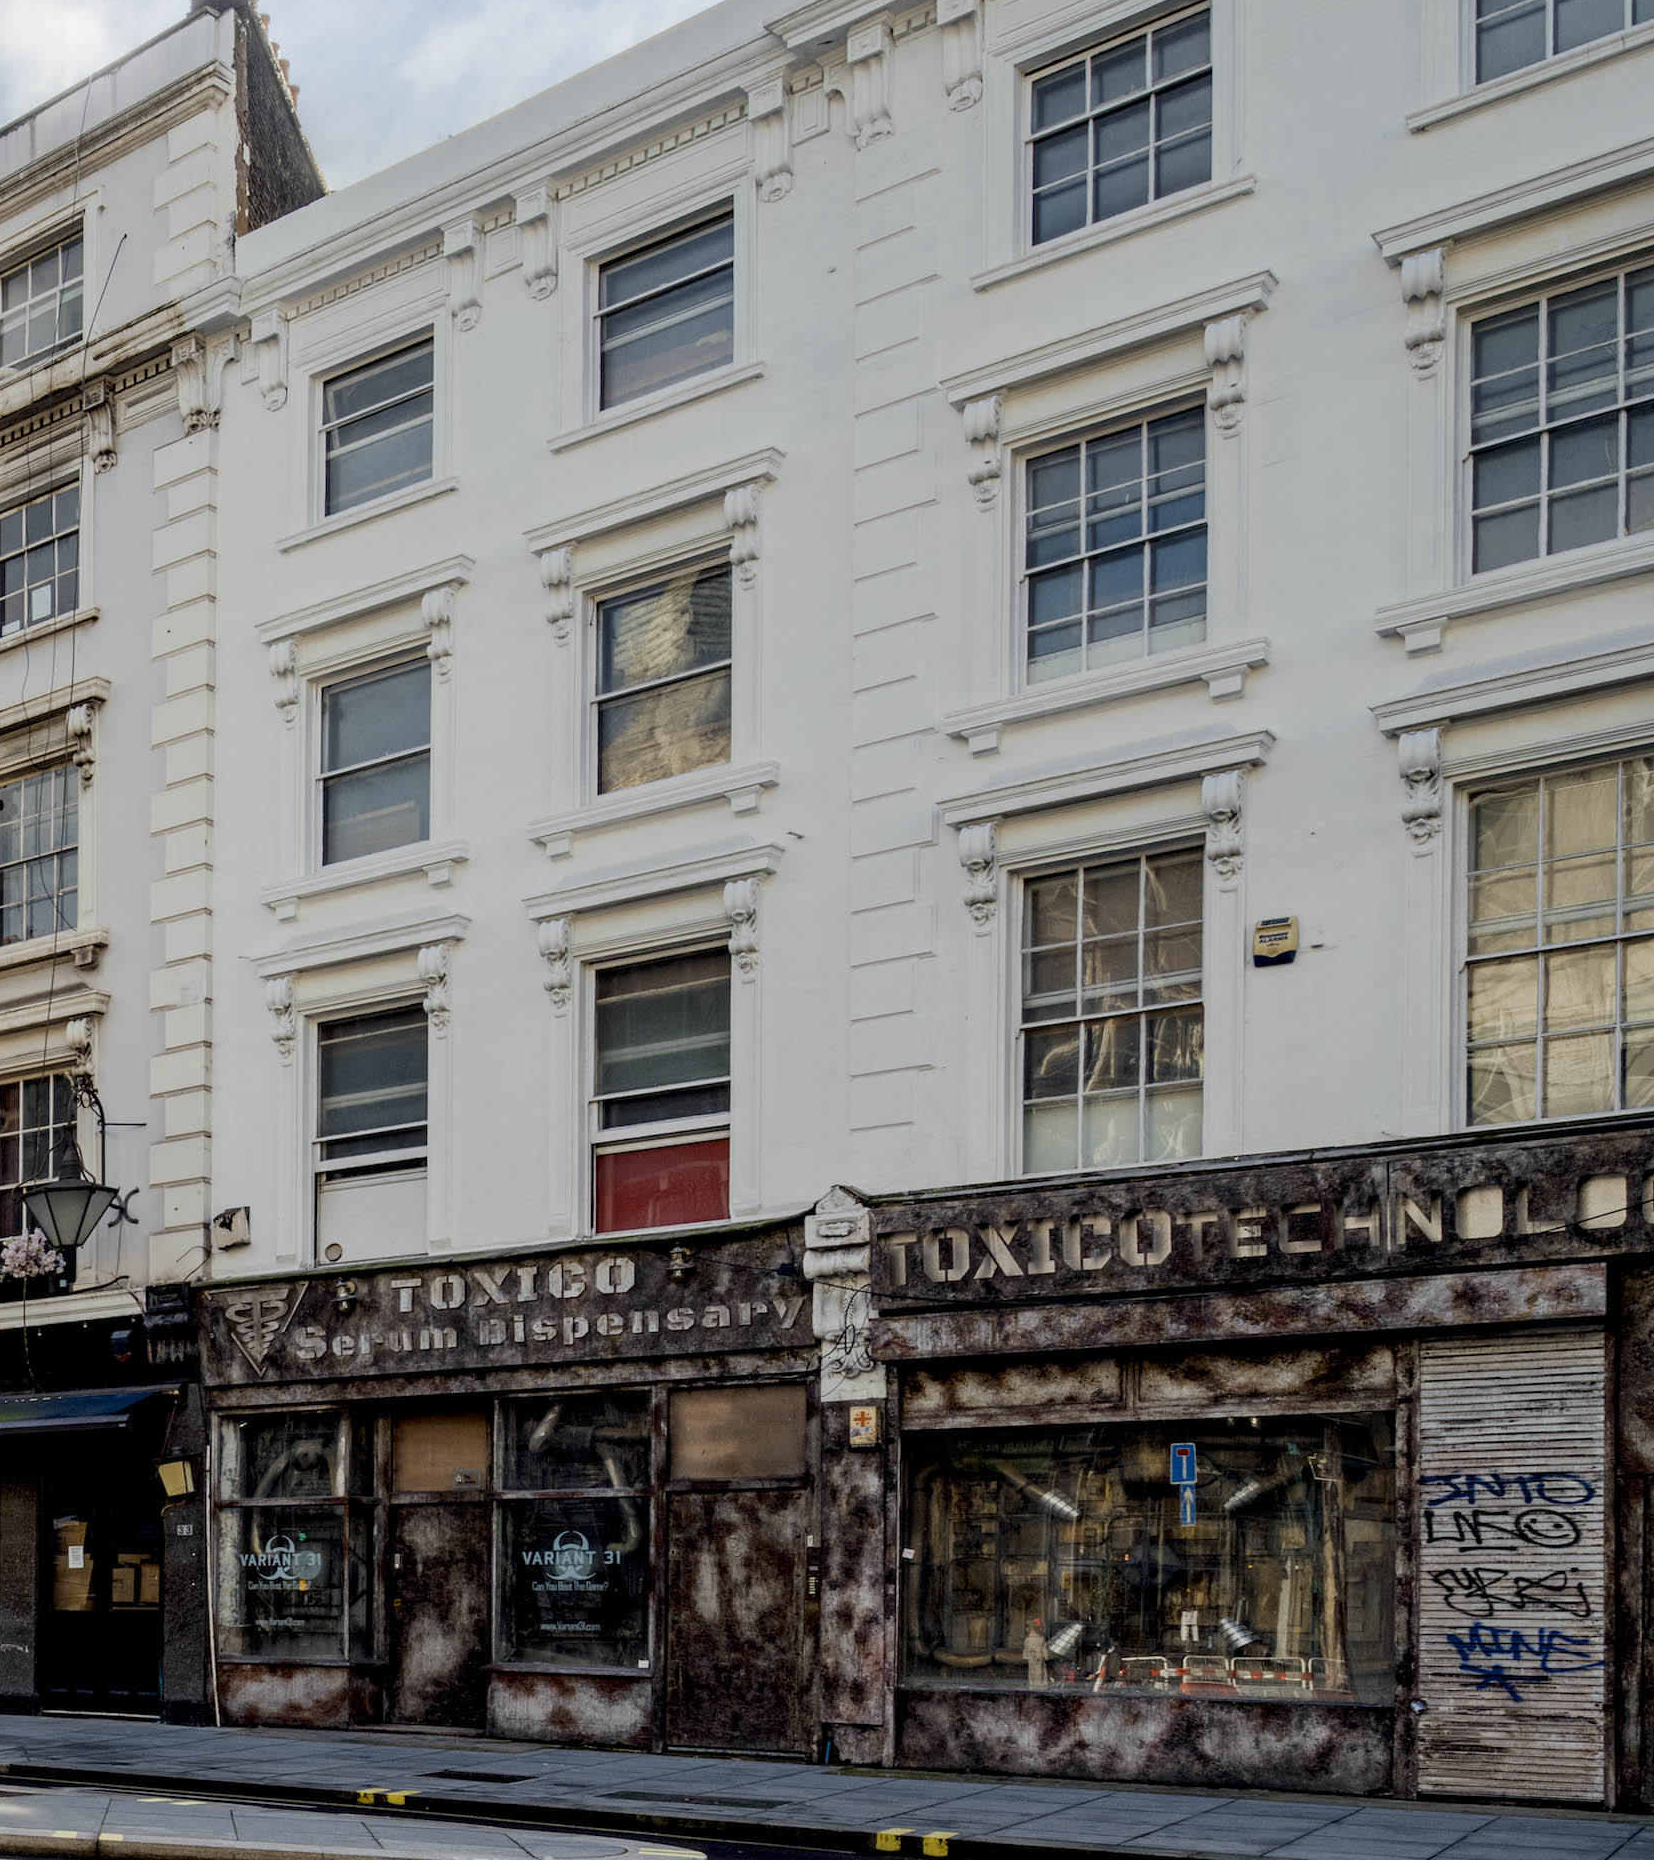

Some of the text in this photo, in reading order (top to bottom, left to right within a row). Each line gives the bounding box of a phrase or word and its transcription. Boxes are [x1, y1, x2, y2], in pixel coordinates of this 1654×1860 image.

[877, 1170, 1654, 1287] TOXICOTECHNOLO
[392, 1256, 637, 1313] TOXICO
[294, 1294, 807, 1360] Serum Dispensary
[178, 1526, 192, 1535] 33
[240, 1552, 322, 1567] VARIANT 31
[522, 1550, 622, 1565] VARIANT 31
[532, 1581, 545, 1591] Can
[545, 1581, 558, 1591] You
